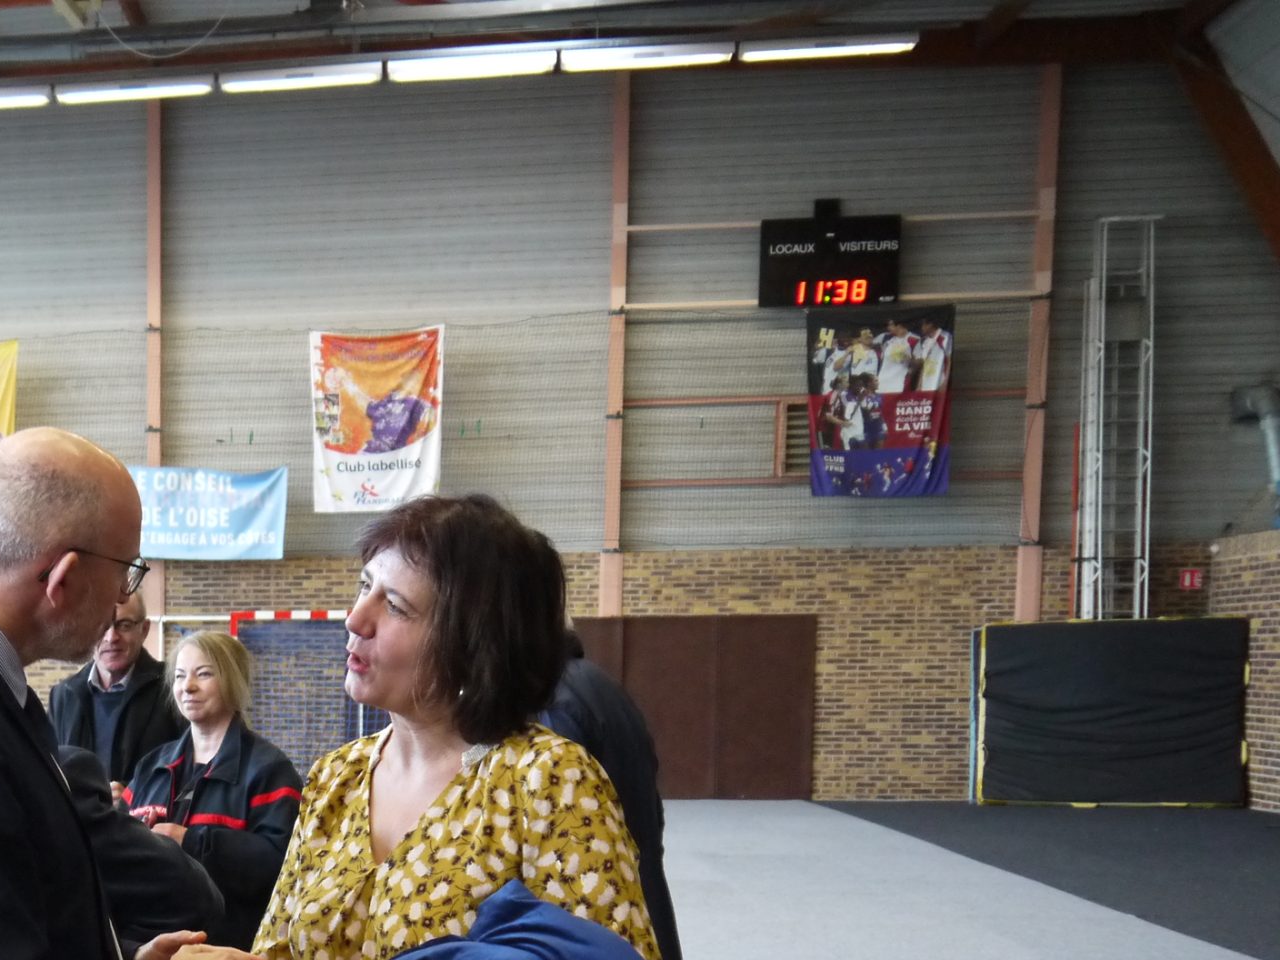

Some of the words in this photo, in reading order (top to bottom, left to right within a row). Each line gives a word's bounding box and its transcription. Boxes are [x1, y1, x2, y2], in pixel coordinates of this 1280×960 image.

[770, 243, 815, 255] LOCAUX
[839, 240, 899, 252] VISITEURS
[795, 279, 868, 304] 11:38
[896, 405, 932, 416] HAND
[895, 422, 911, 431] LA
[336, 460, 365, 473] Club
[368, 456, 422, 472] labellisé
[823, 455, 845, 463] CLUB
[153, 470, 236, 493] CONSEIL
[143, 507, 162, 527] DE
[168, 507, 230, 528] L'OISE
[210, 532, 233, 545] VOS
